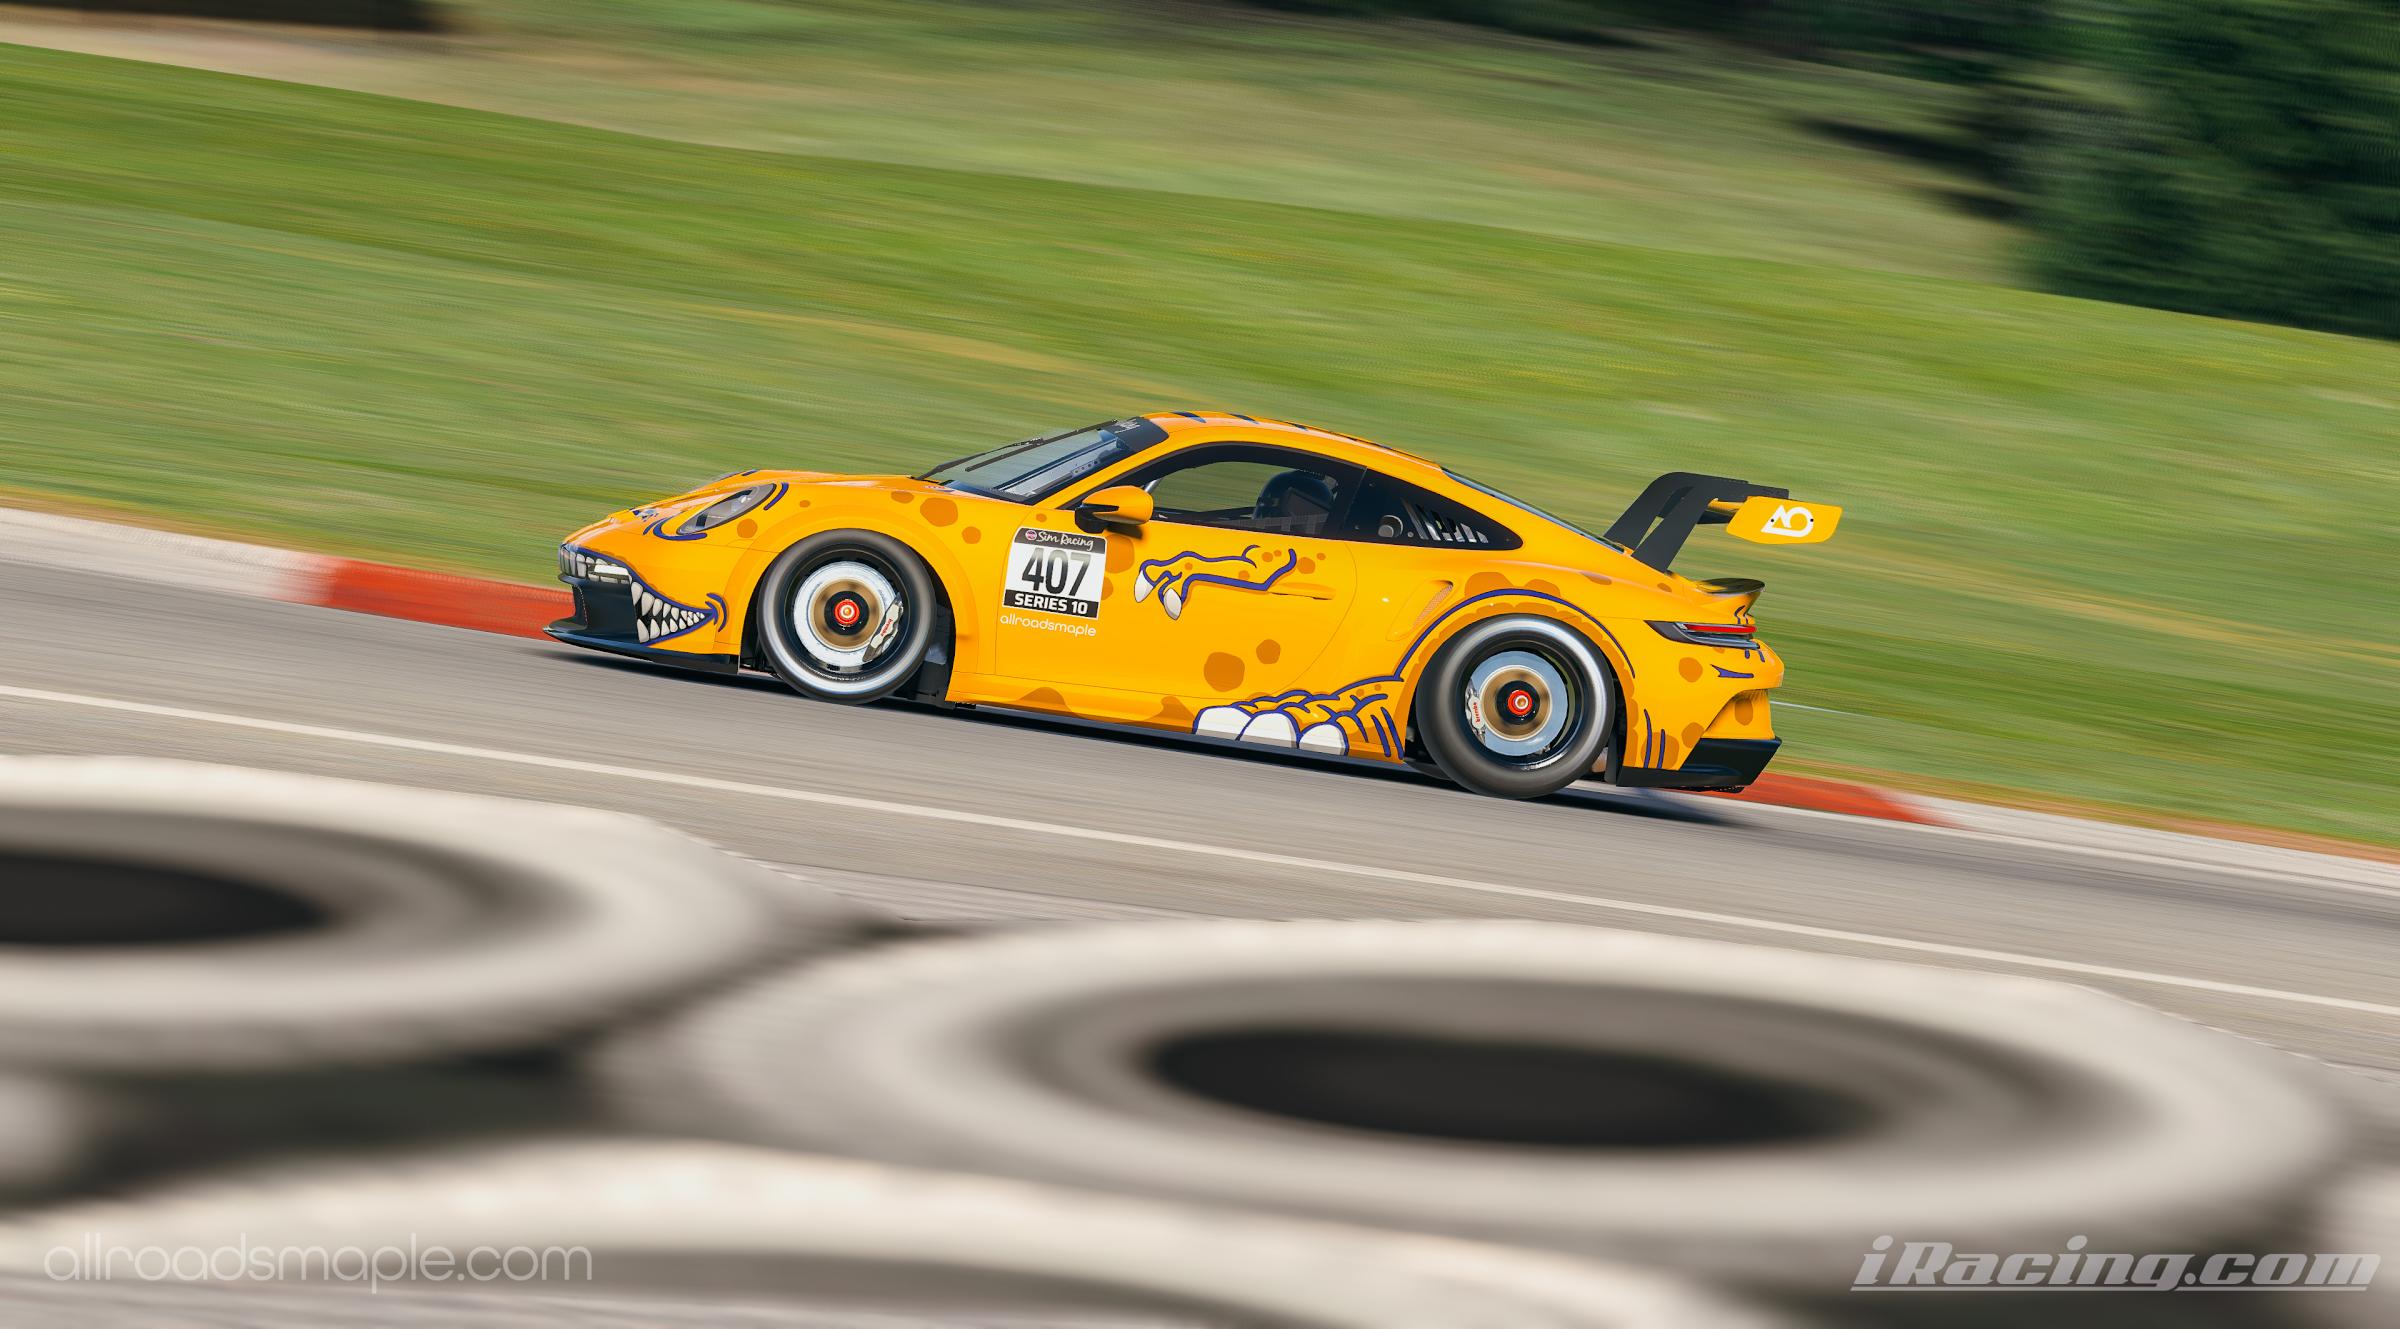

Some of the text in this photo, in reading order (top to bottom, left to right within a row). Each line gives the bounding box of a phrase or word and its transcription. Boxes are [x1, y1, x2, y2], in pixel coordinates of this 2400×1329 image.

[1036, 530, 1094, 552] Sim Racing
[1021, 547, 1092, 597] 407
[1014, 593, 1088, 615] SERIES 10
[1000, 613, 1097, 637] allroadsmaple
